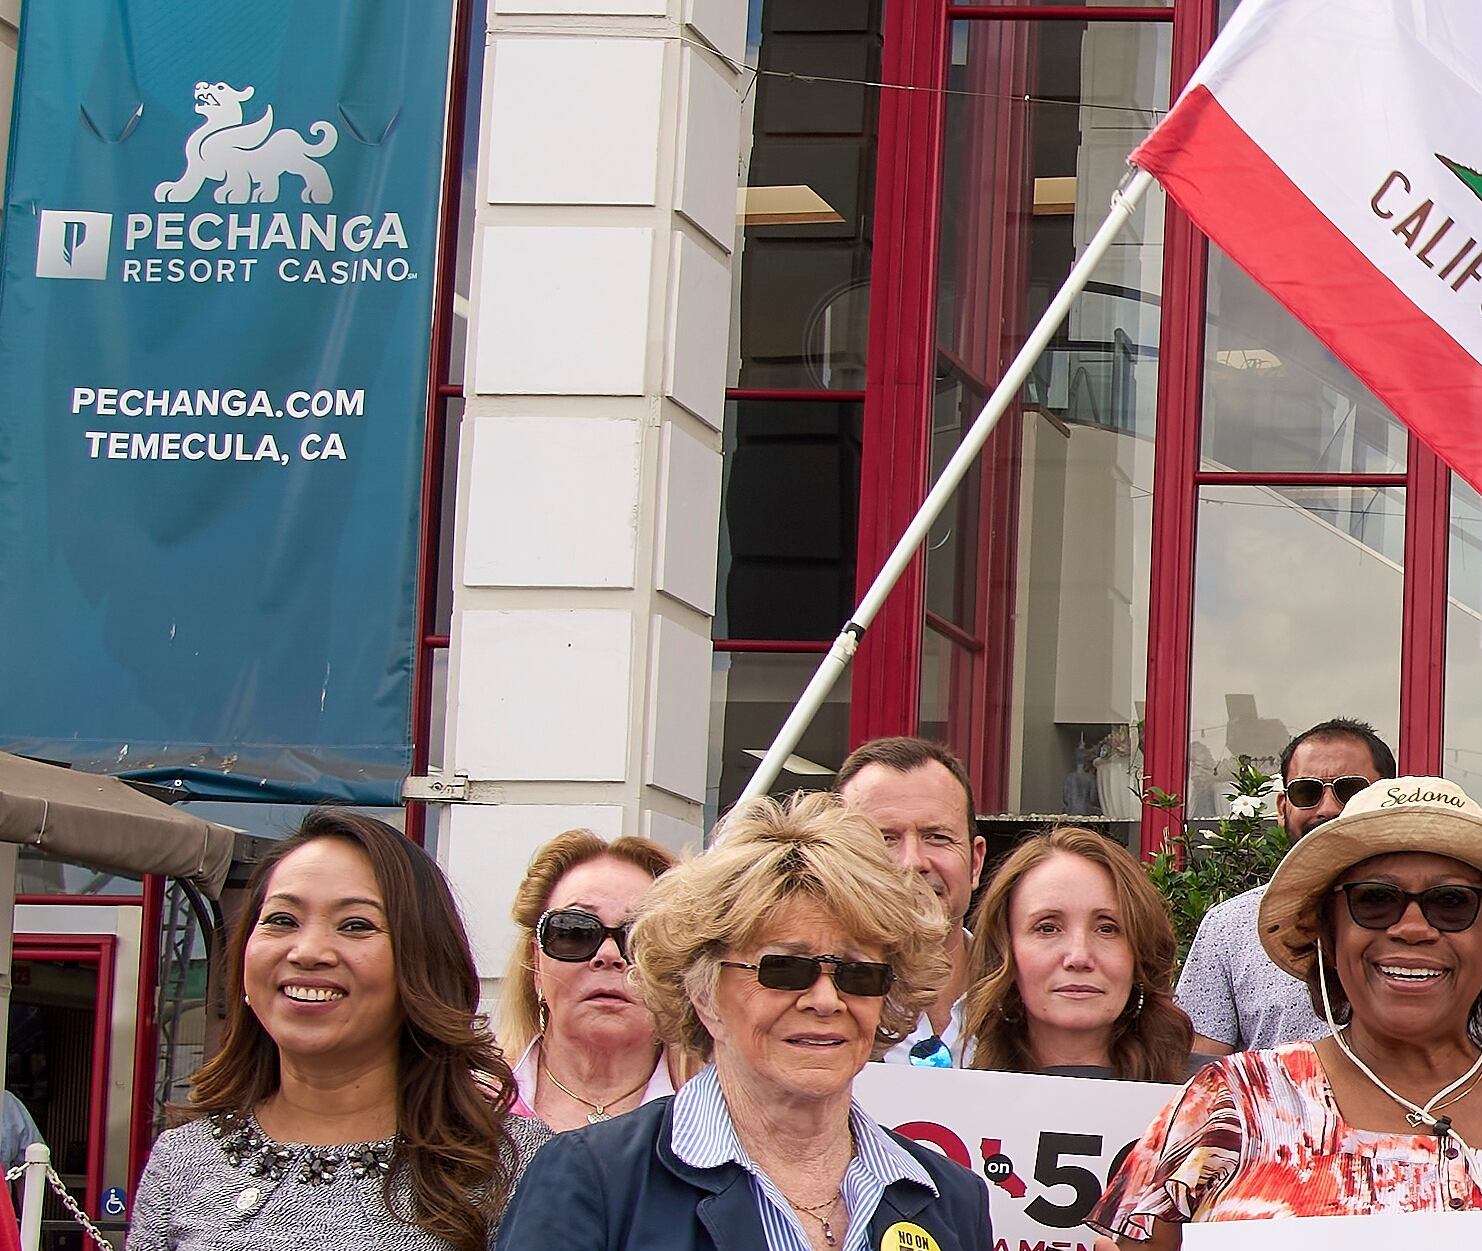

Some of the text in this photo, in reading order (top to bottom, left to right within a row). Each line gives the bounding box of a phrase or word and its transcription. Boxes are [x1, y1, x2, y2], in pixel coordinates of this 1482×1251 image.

[125, 212, 409, 252] PECHANGA
[122, 258, 258, 283] RESORT
[278, 257, 409, 285] CASINO
[72, 387, 365, 418] PECHANGA.COM
[85, 431, 347, 466] TEMECULA, CA
[1380, 787, 1467, 808] Sedona
[987, 1161, 1010, 1175] on
[1024, 1131, 1141, 1229] 5
[898, 1231, 930, 1251] NO ON
